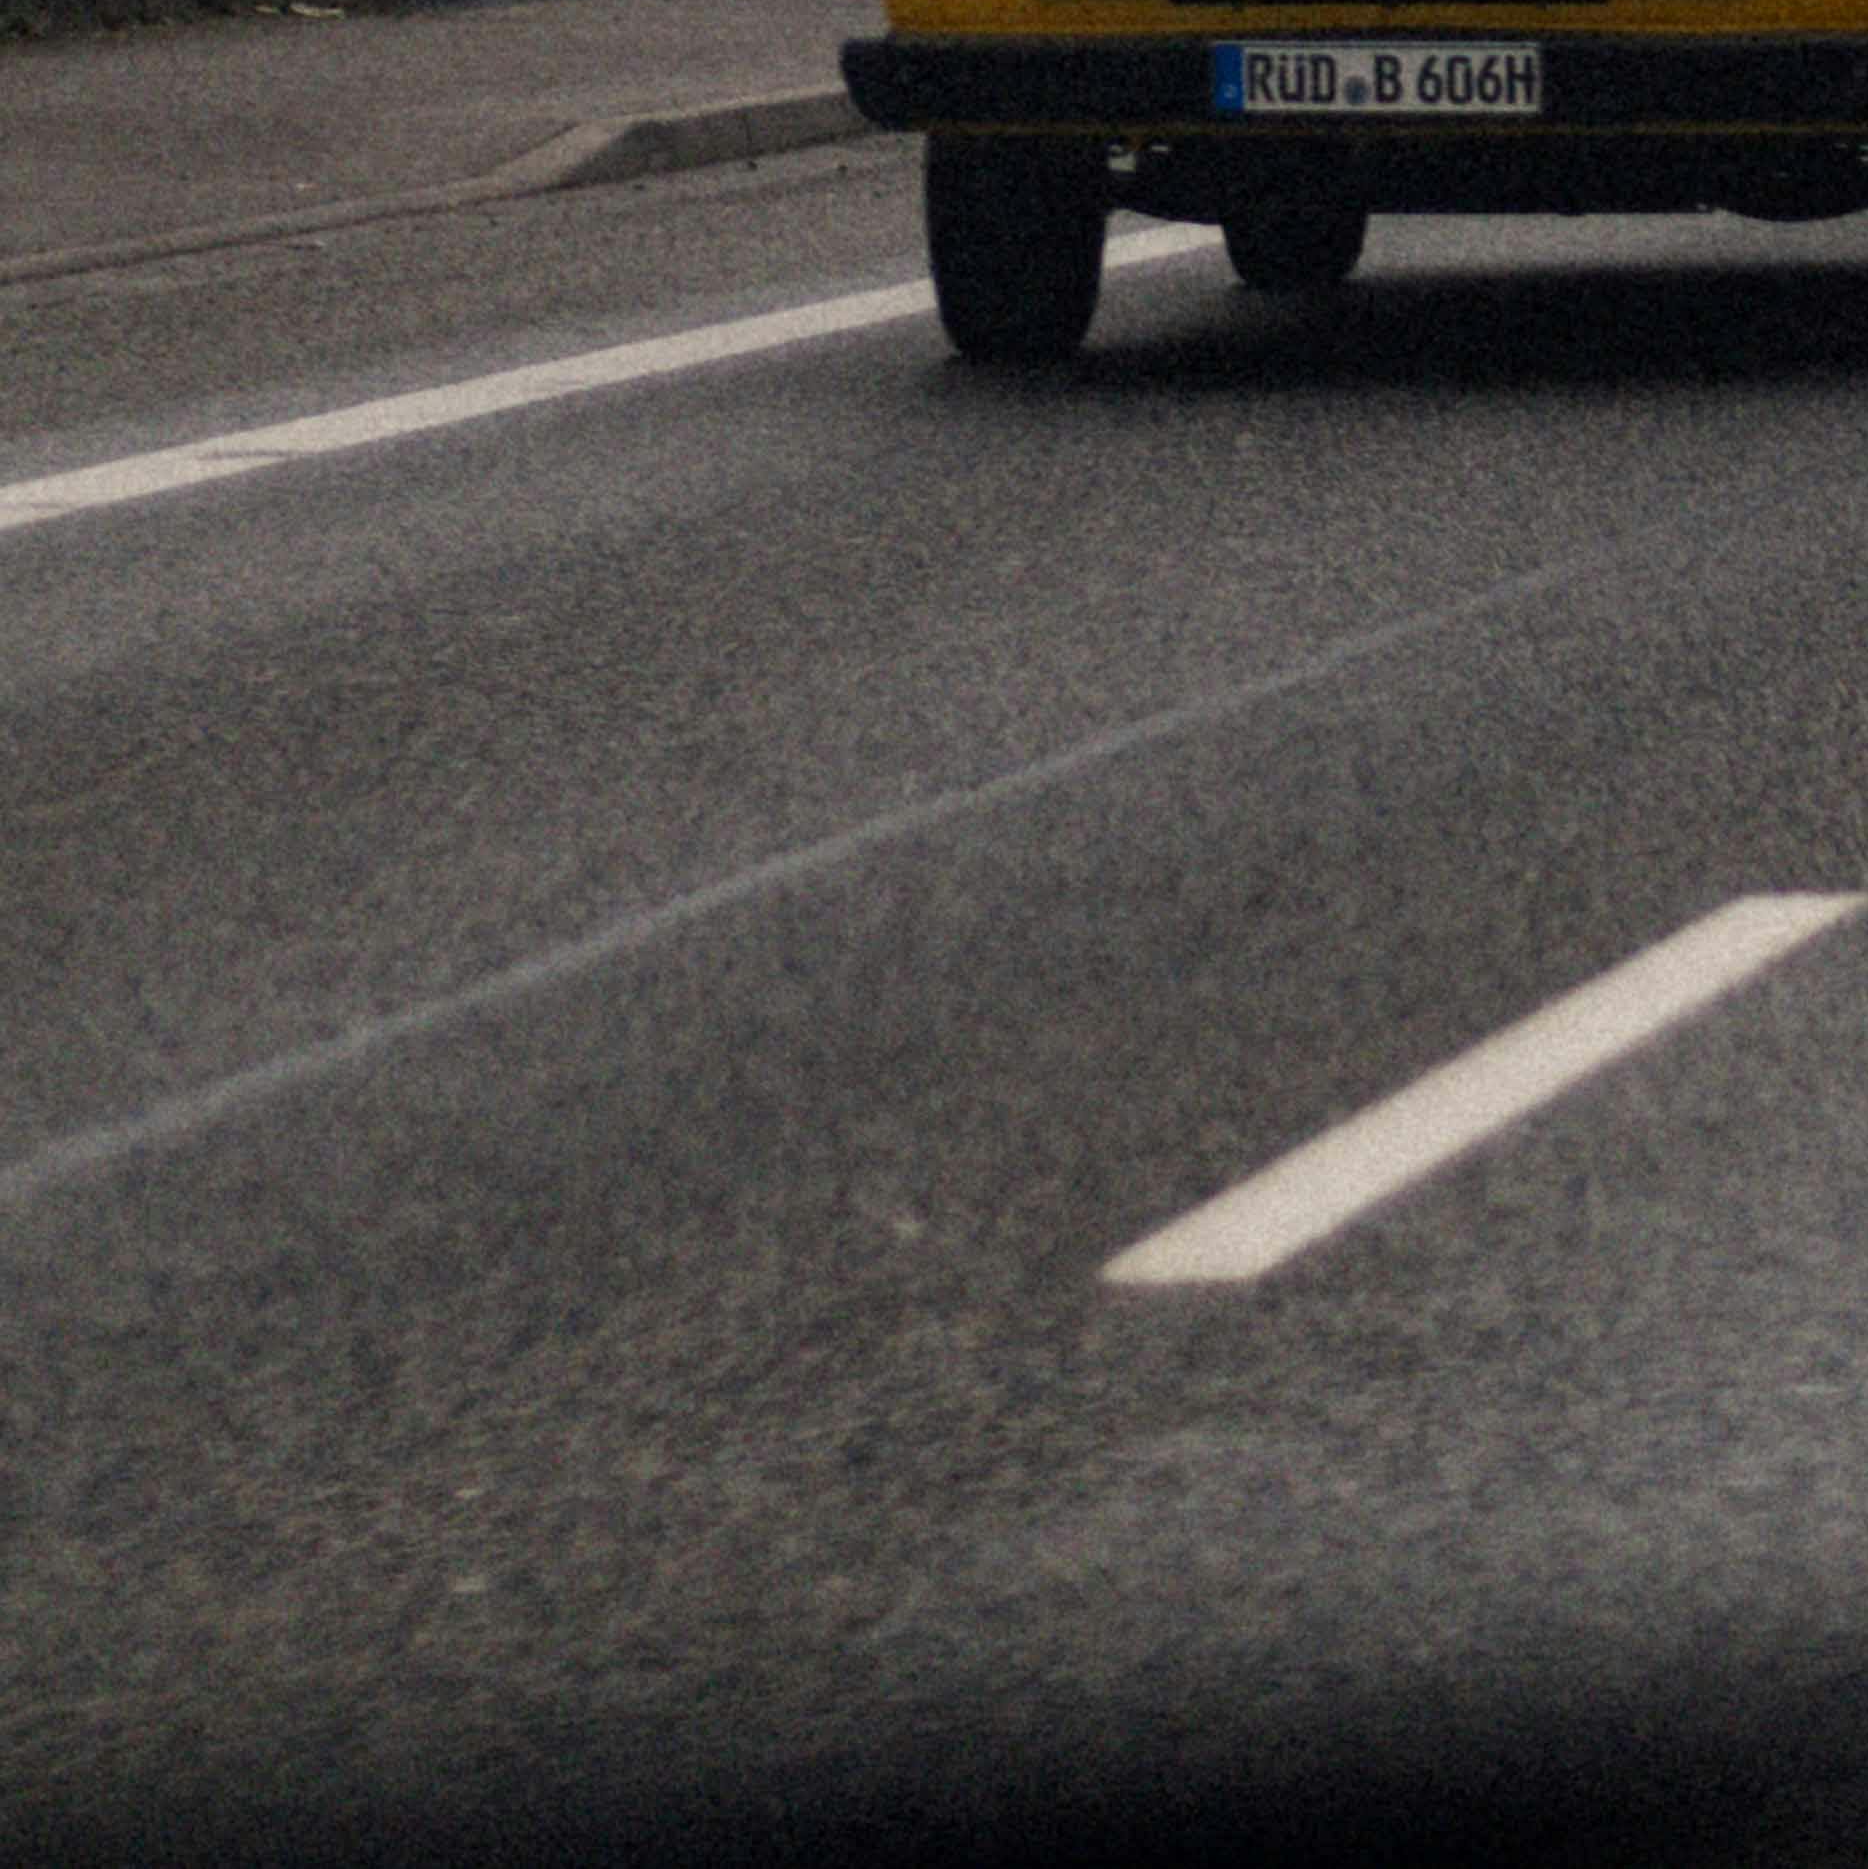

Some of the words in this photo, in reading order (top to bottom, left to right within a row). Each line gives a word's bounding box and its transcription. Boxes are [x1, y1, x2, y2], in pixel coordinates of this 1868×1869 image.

[1246, 53, 1337, 103] RÜD
[1373, 55, 1402, 103] B
[1416, 55, 1534, 104] 606H
